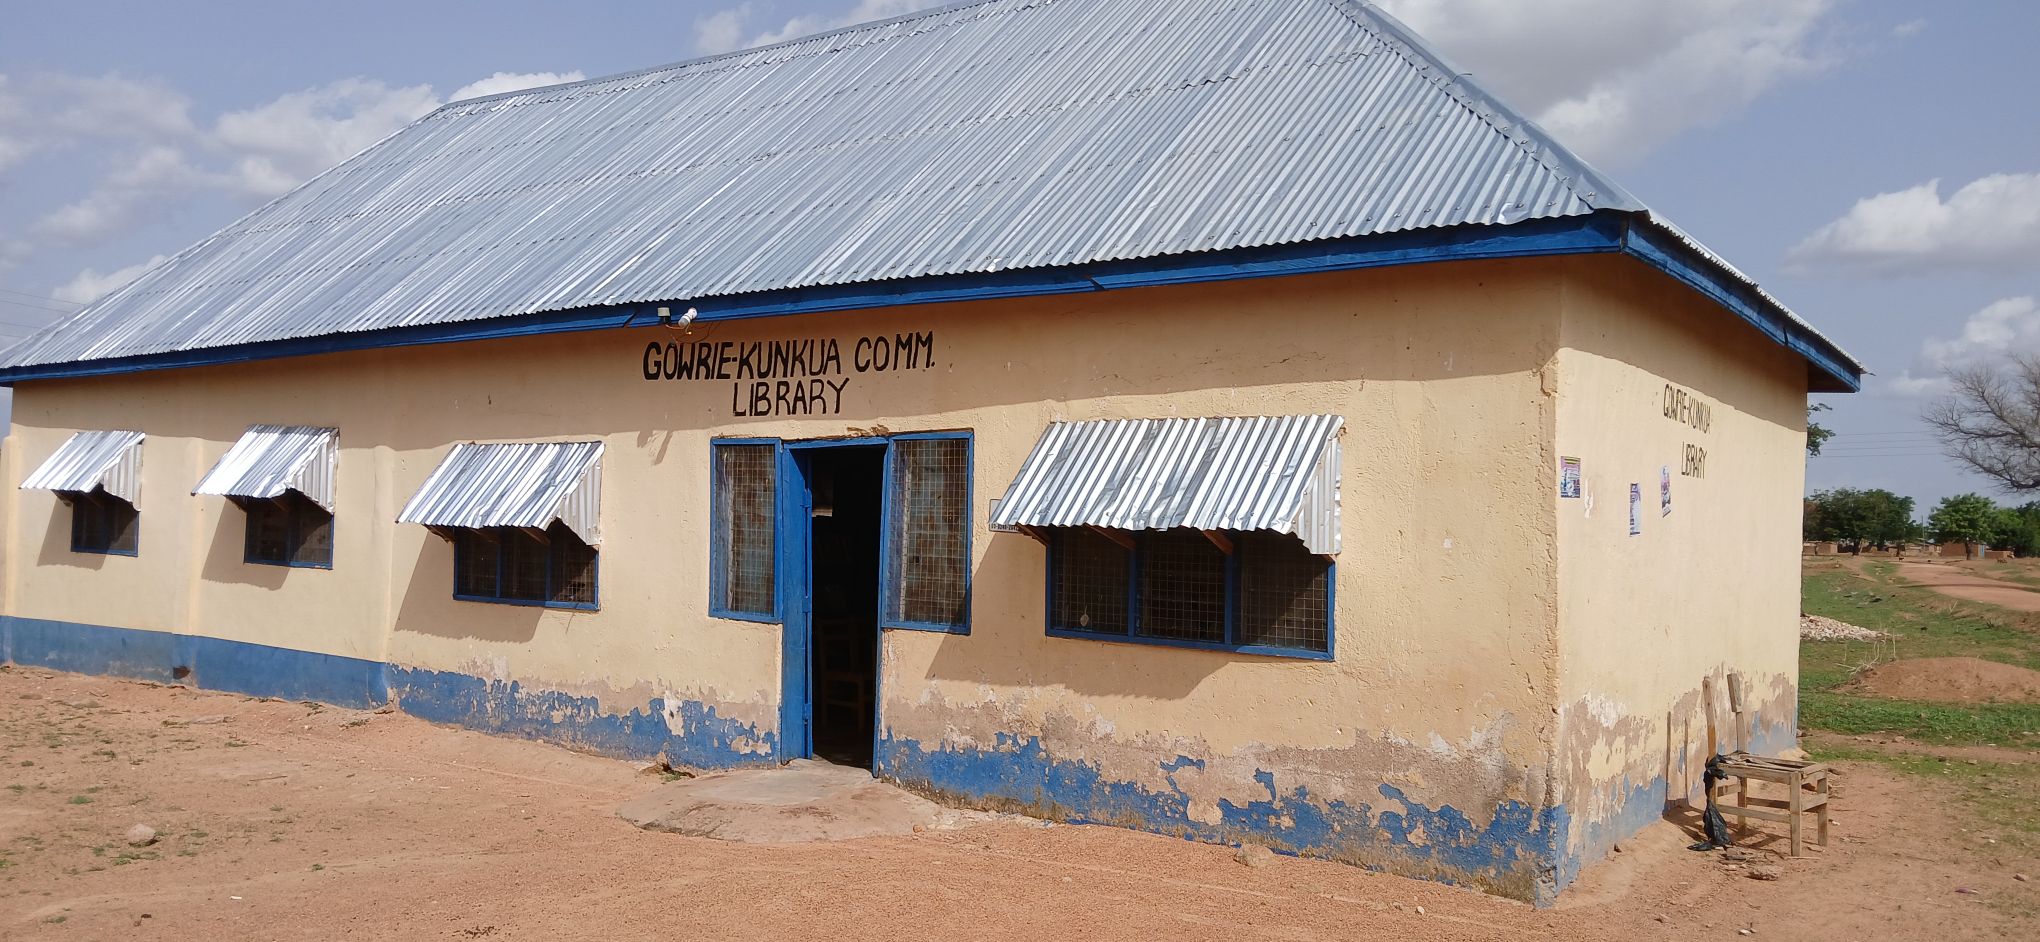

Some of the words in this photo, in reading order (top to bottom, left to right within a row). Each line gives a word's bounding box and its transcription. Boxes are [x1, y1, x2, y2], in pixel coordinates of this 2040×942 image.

[643, 338, 842, 381] GOWRIE-KUNKUA
[854, 331, 936, 373] COMM.
[733, 377, 850, 417] LIBRARY
[1681, 441, 1707, 479] LIBRARY
